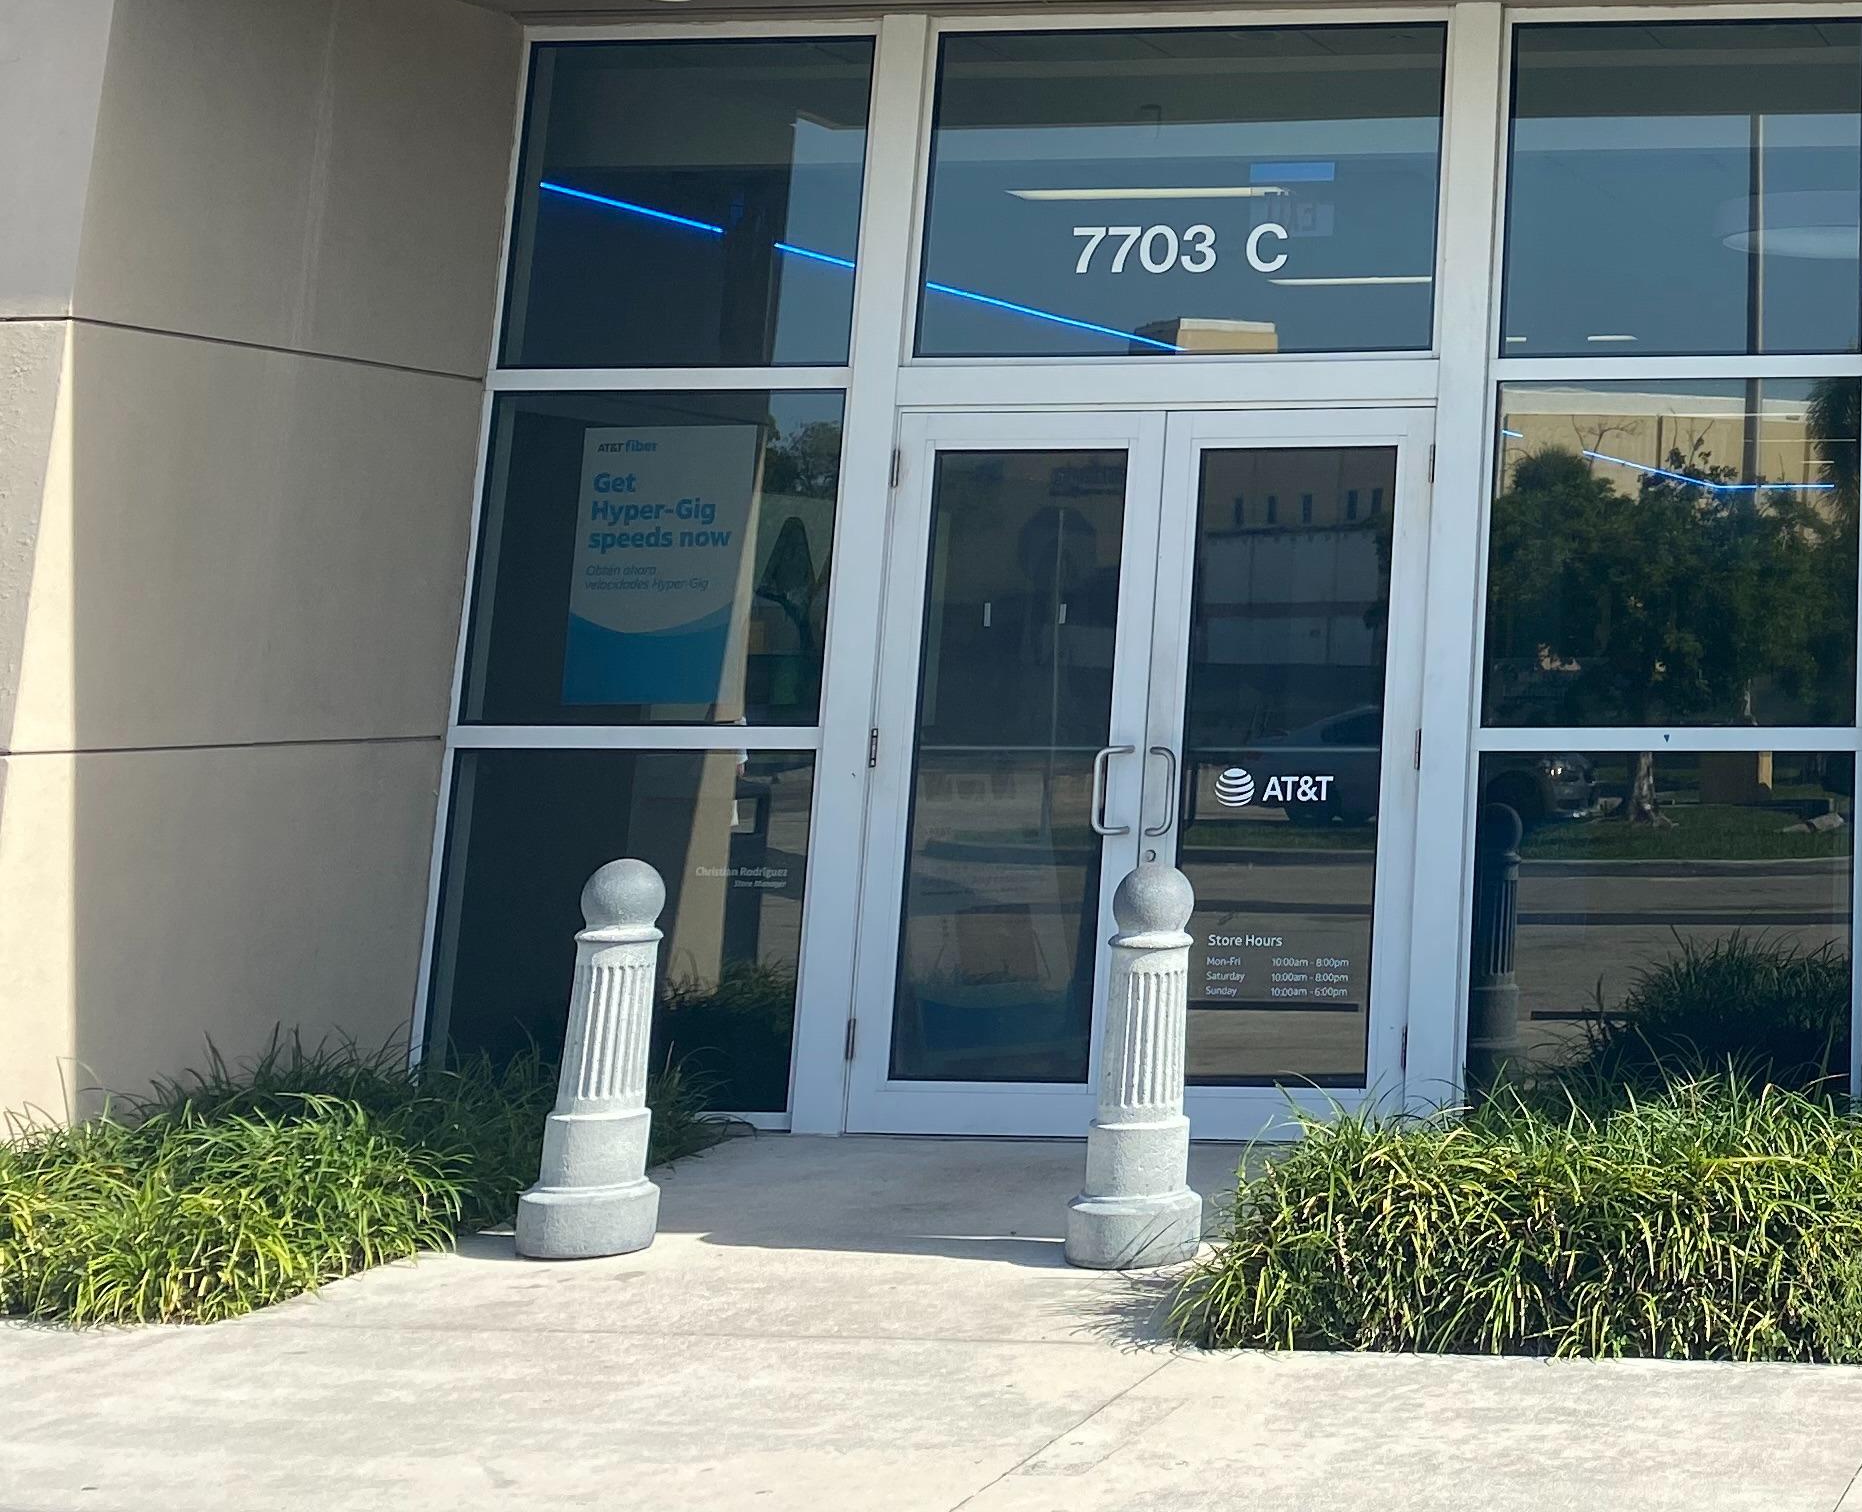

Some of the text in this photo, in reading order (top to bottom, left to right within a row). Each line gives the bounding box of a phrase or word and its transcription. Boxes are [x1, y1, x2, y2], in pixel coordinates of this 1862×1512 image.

[1073, 222, 1289, 274] 7703 C
[593, 473, 636, 493] Get
[591, 498, 716, 526] Hyper-Gig
[588, 527, 732, 554] speeds now
[1262, 775, 1334, 802] AT&T
[1208, 934, 1283, 946] Store Hours
[1206, 956, 1241, 966] Mon-Fri
[1206, 971, 1245, 983] Saturday
[1205, 986, 1238, 997] Sunday
